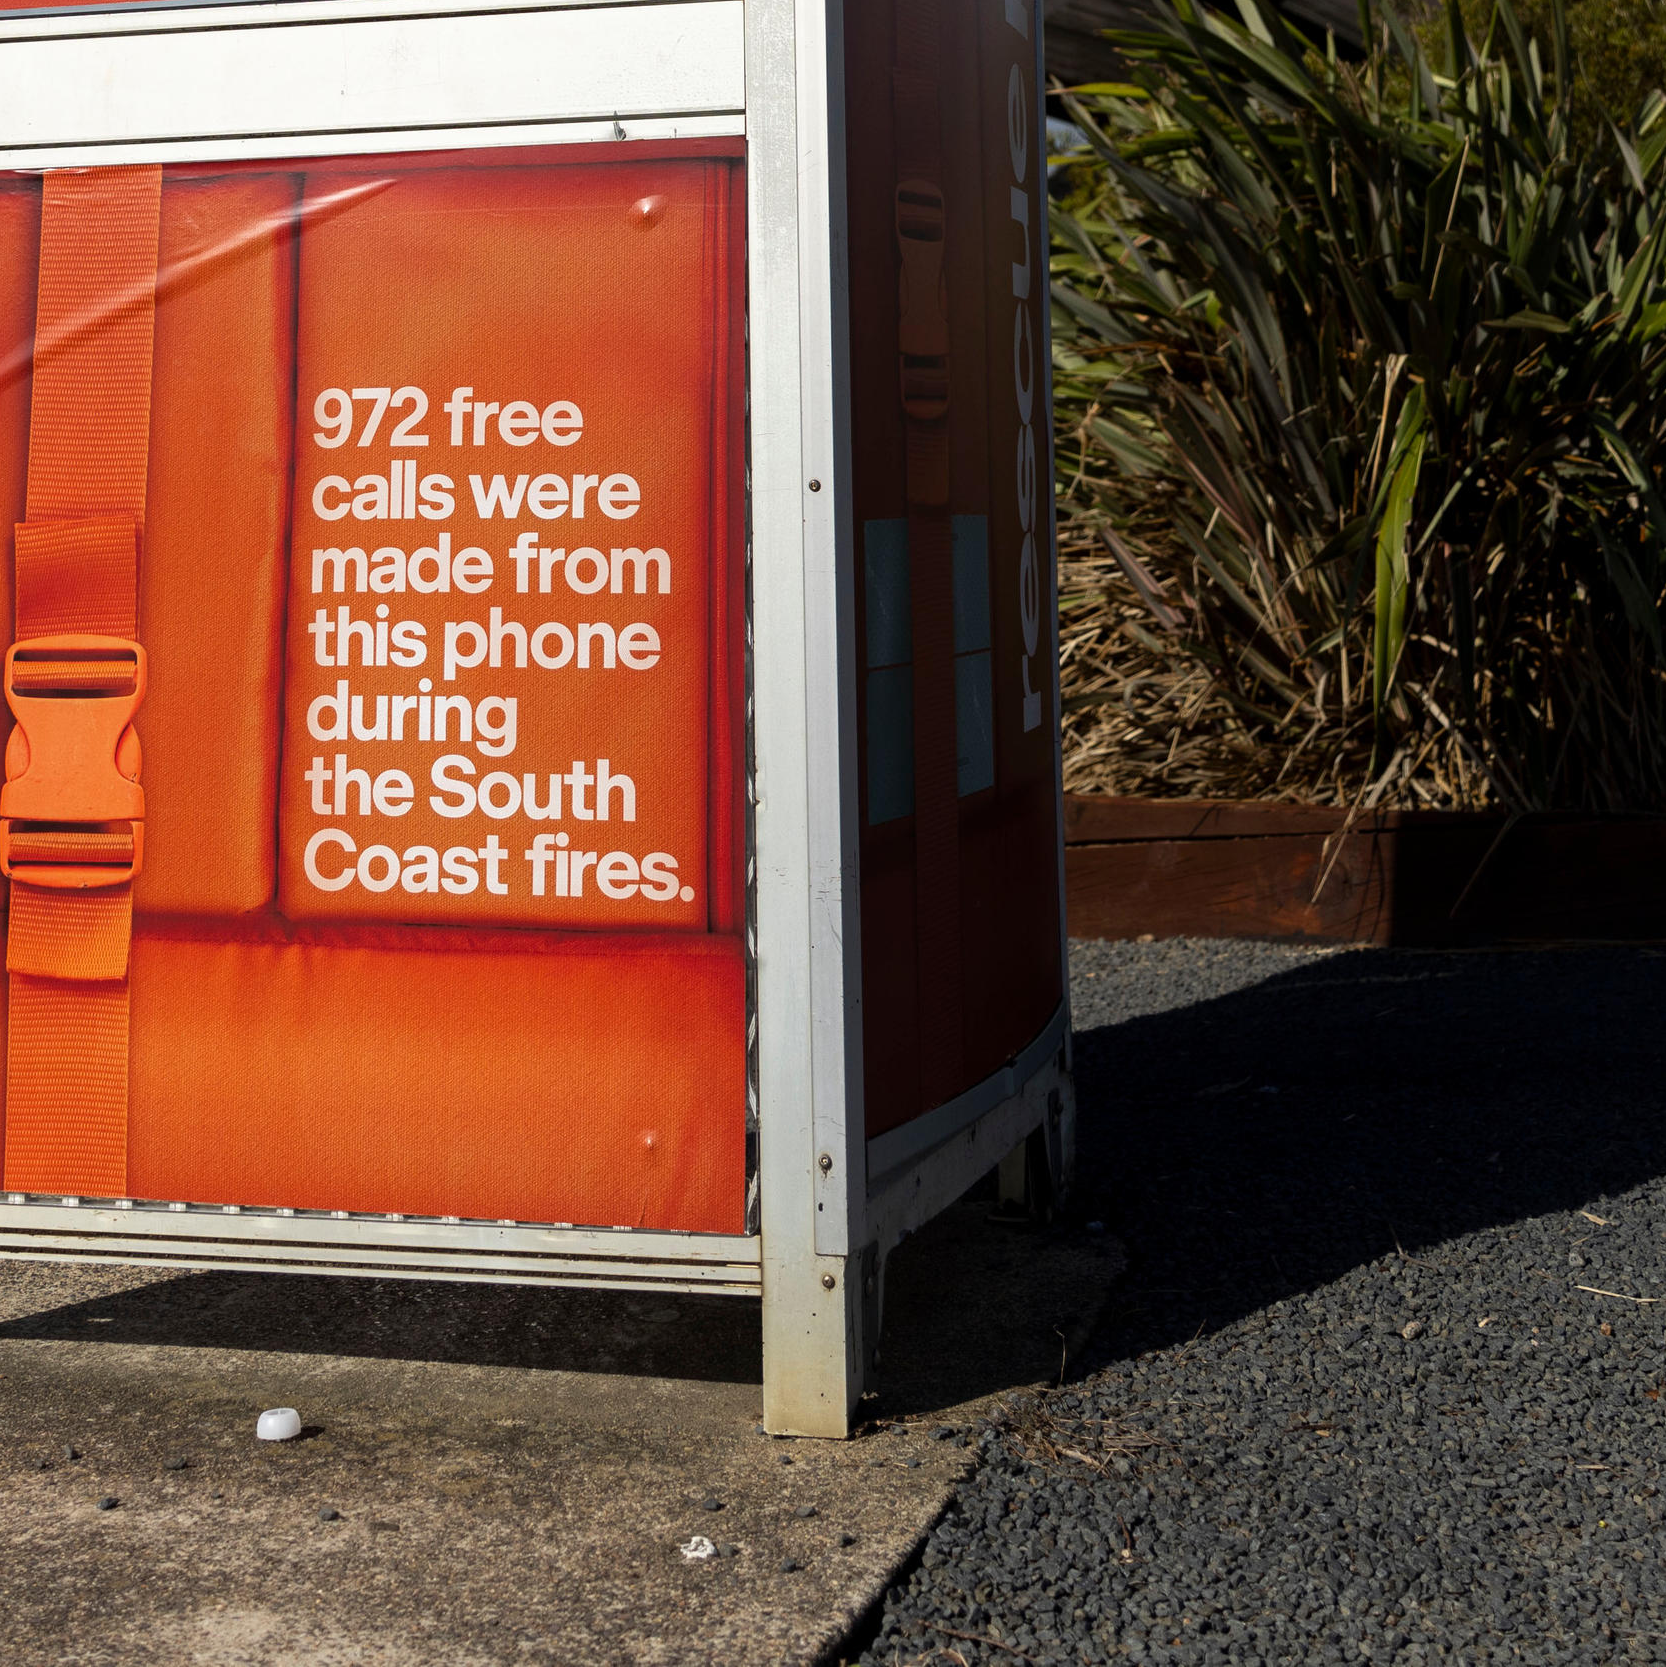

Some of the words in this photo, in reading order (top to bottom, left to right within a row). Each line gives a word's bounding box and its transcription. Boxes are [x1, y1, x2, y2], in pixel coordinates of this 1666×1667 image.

[312, 386, 430, 449] 972
[443, 386, 584, 447] free
[1008, 62, 1042, 733] rescue
[311, 459, 455, 521] calls
[469, 472, 641, 520] were
[311, 533, 494, 593] made
[508, 533, 671, 595] from
[308, 603, 428, 668] this
[443, 606, 661, 681] phone
[306, 678, 518, 757] during
[304, 754, 415, 817] the
[429, 754, 636, 822] South
[303, 828, 509, 895] Coast
[524, 832, 696, 902] fires.
